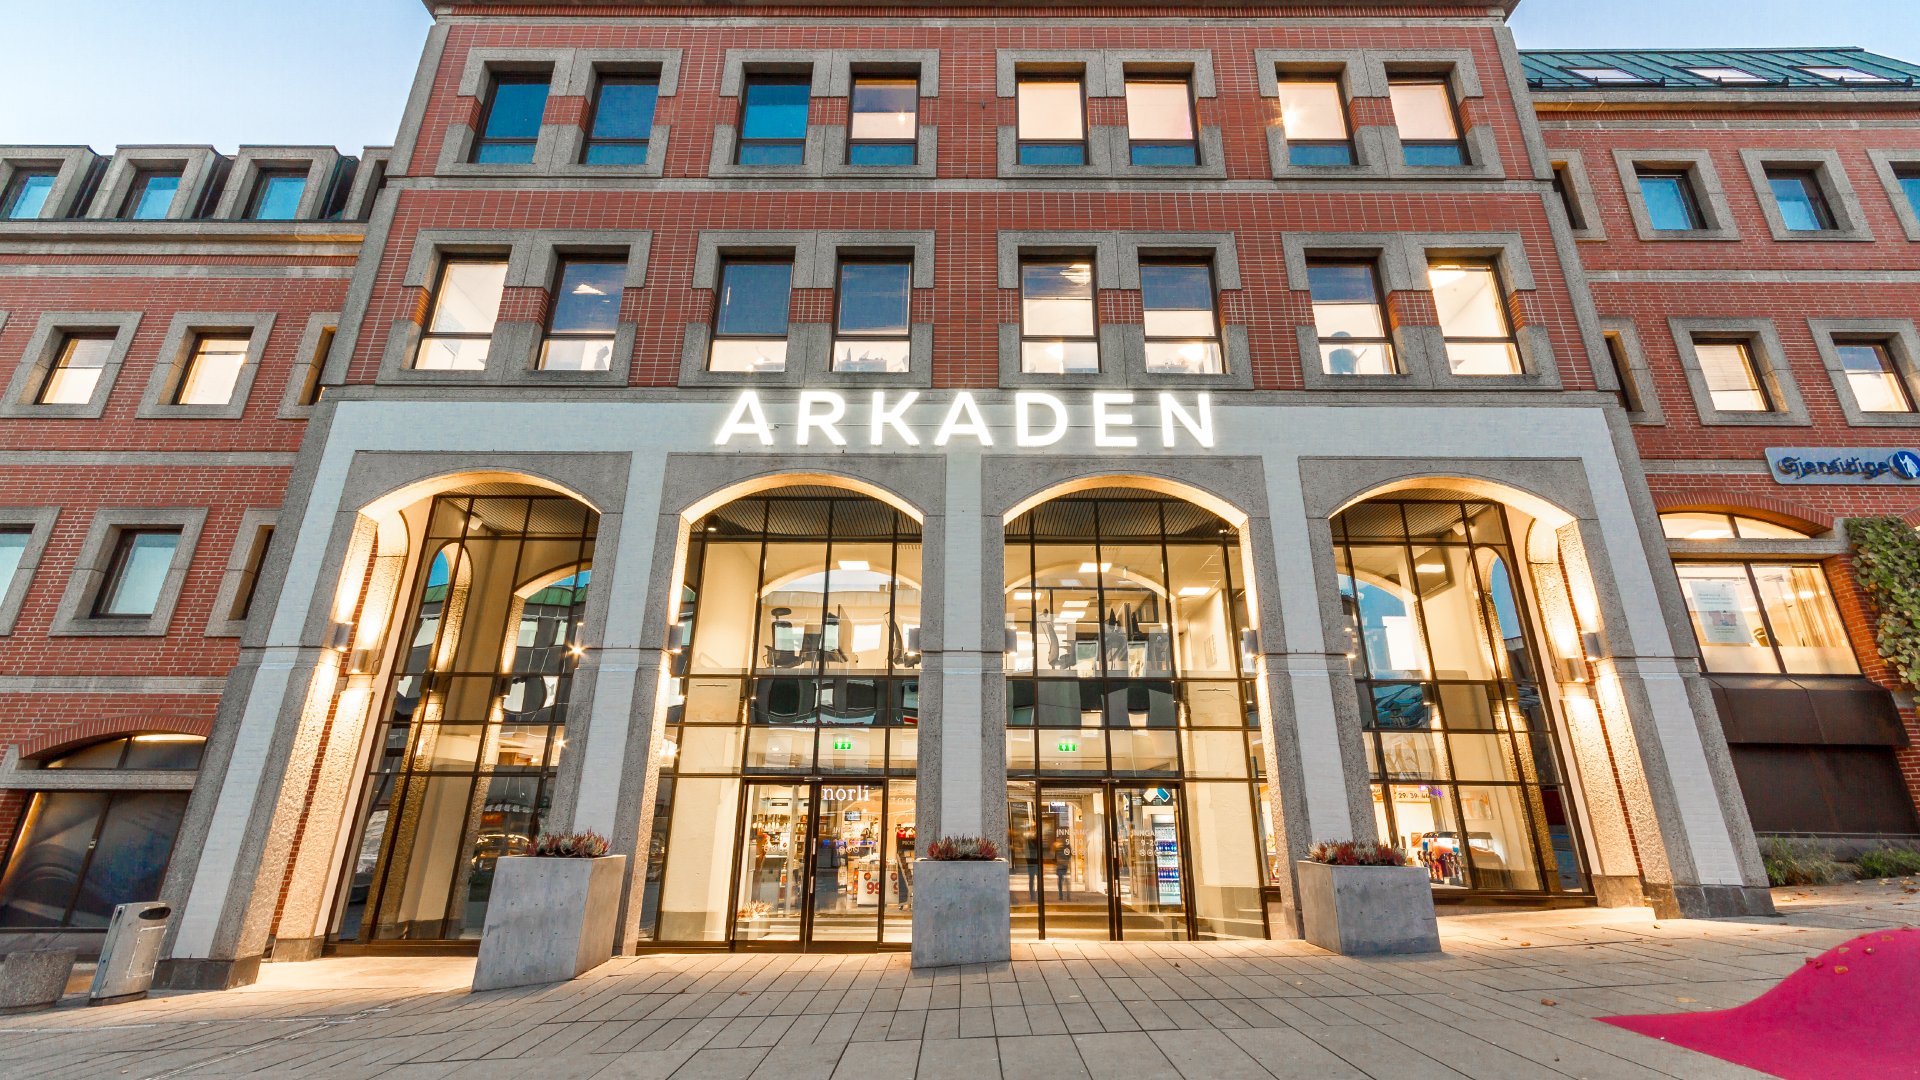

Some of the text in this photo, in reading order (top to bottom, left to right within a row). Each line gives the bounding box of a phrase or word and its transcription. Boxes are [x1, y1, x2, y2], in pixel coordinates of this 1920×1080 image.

[714, 390, 1216, 447] ARKADEN
[1778, 456, 1889, 479] Gjensidige
[821, 785, 870, 801] norli
[1056, 829, 1089, 837] INNAN
